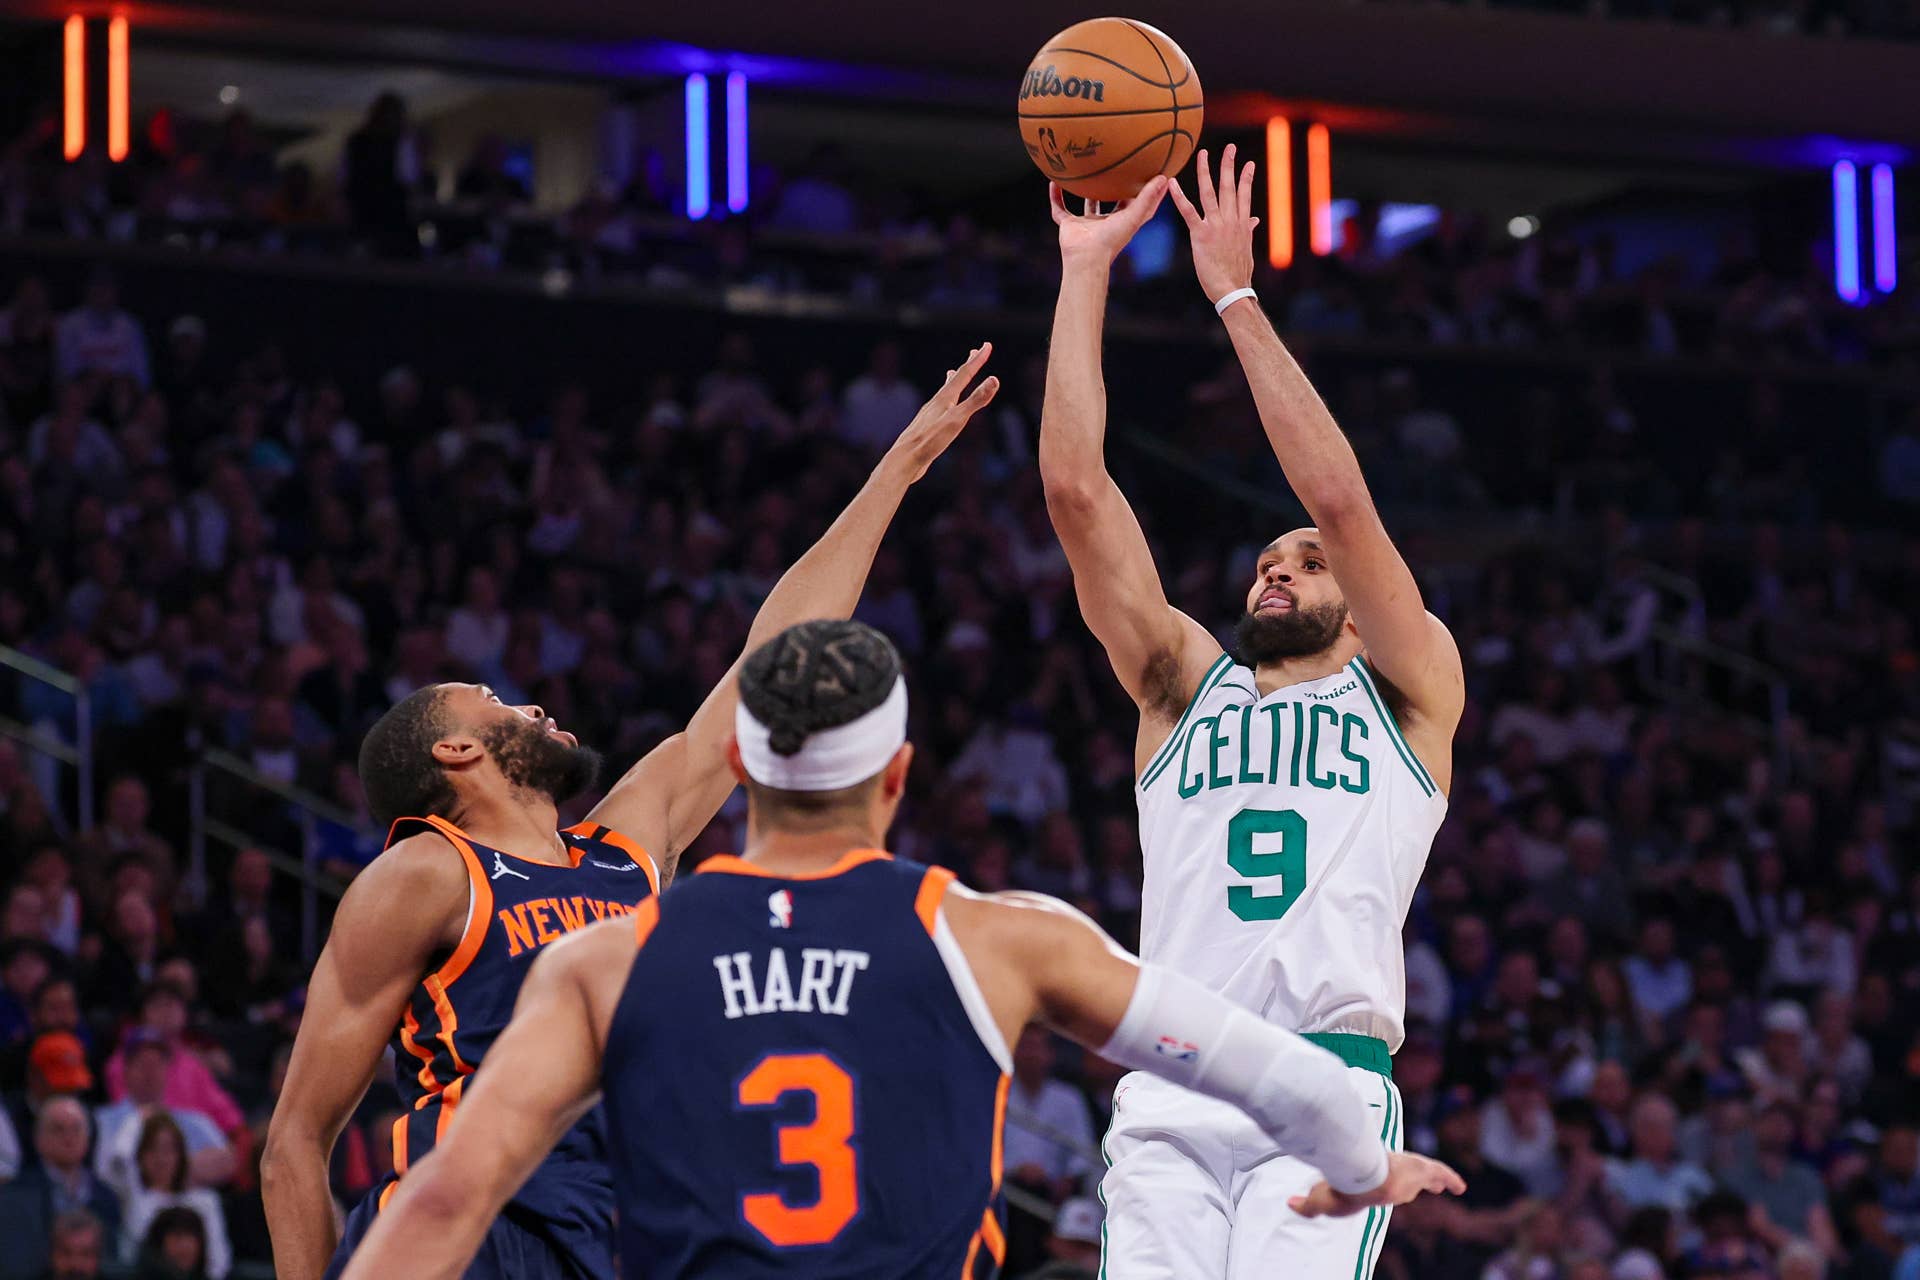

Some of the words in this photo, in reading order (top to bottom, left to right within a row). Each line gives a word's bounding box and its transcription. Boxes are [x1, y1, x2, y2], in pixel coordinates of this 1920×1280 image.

[1178, 701, 1370, 800] CELTICS
[1227, 808, 1308, 922] 9
[713, 947, 870, 1019] HART
[736, 1051, 861, 1249] 3
